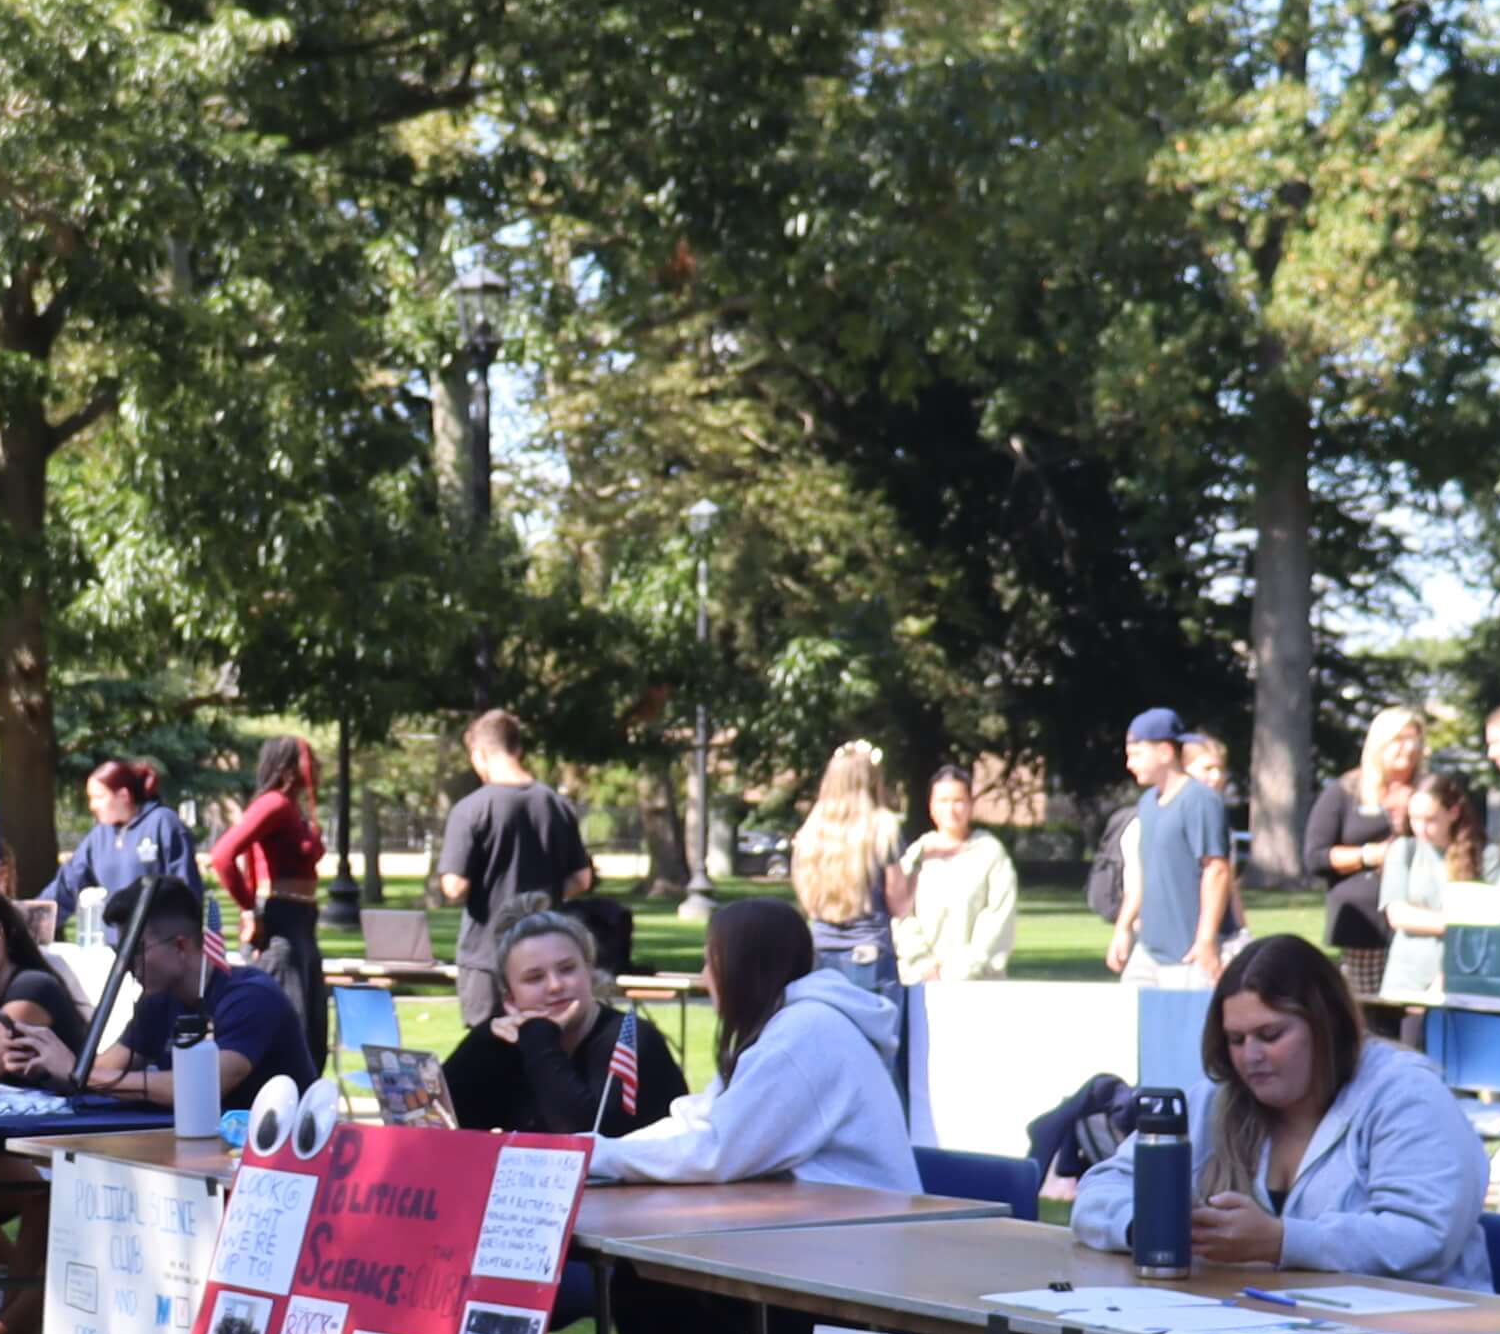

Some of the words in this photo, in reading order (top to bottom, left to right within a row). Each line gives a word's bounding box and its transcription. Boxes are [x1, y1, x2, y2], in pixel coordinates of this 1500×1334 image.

[318, 1129, 439, 1220] POLITICAL
[73, 1179, 146, 1226] POLITICAL
[230, 1205, 284, 1235] WHAT
